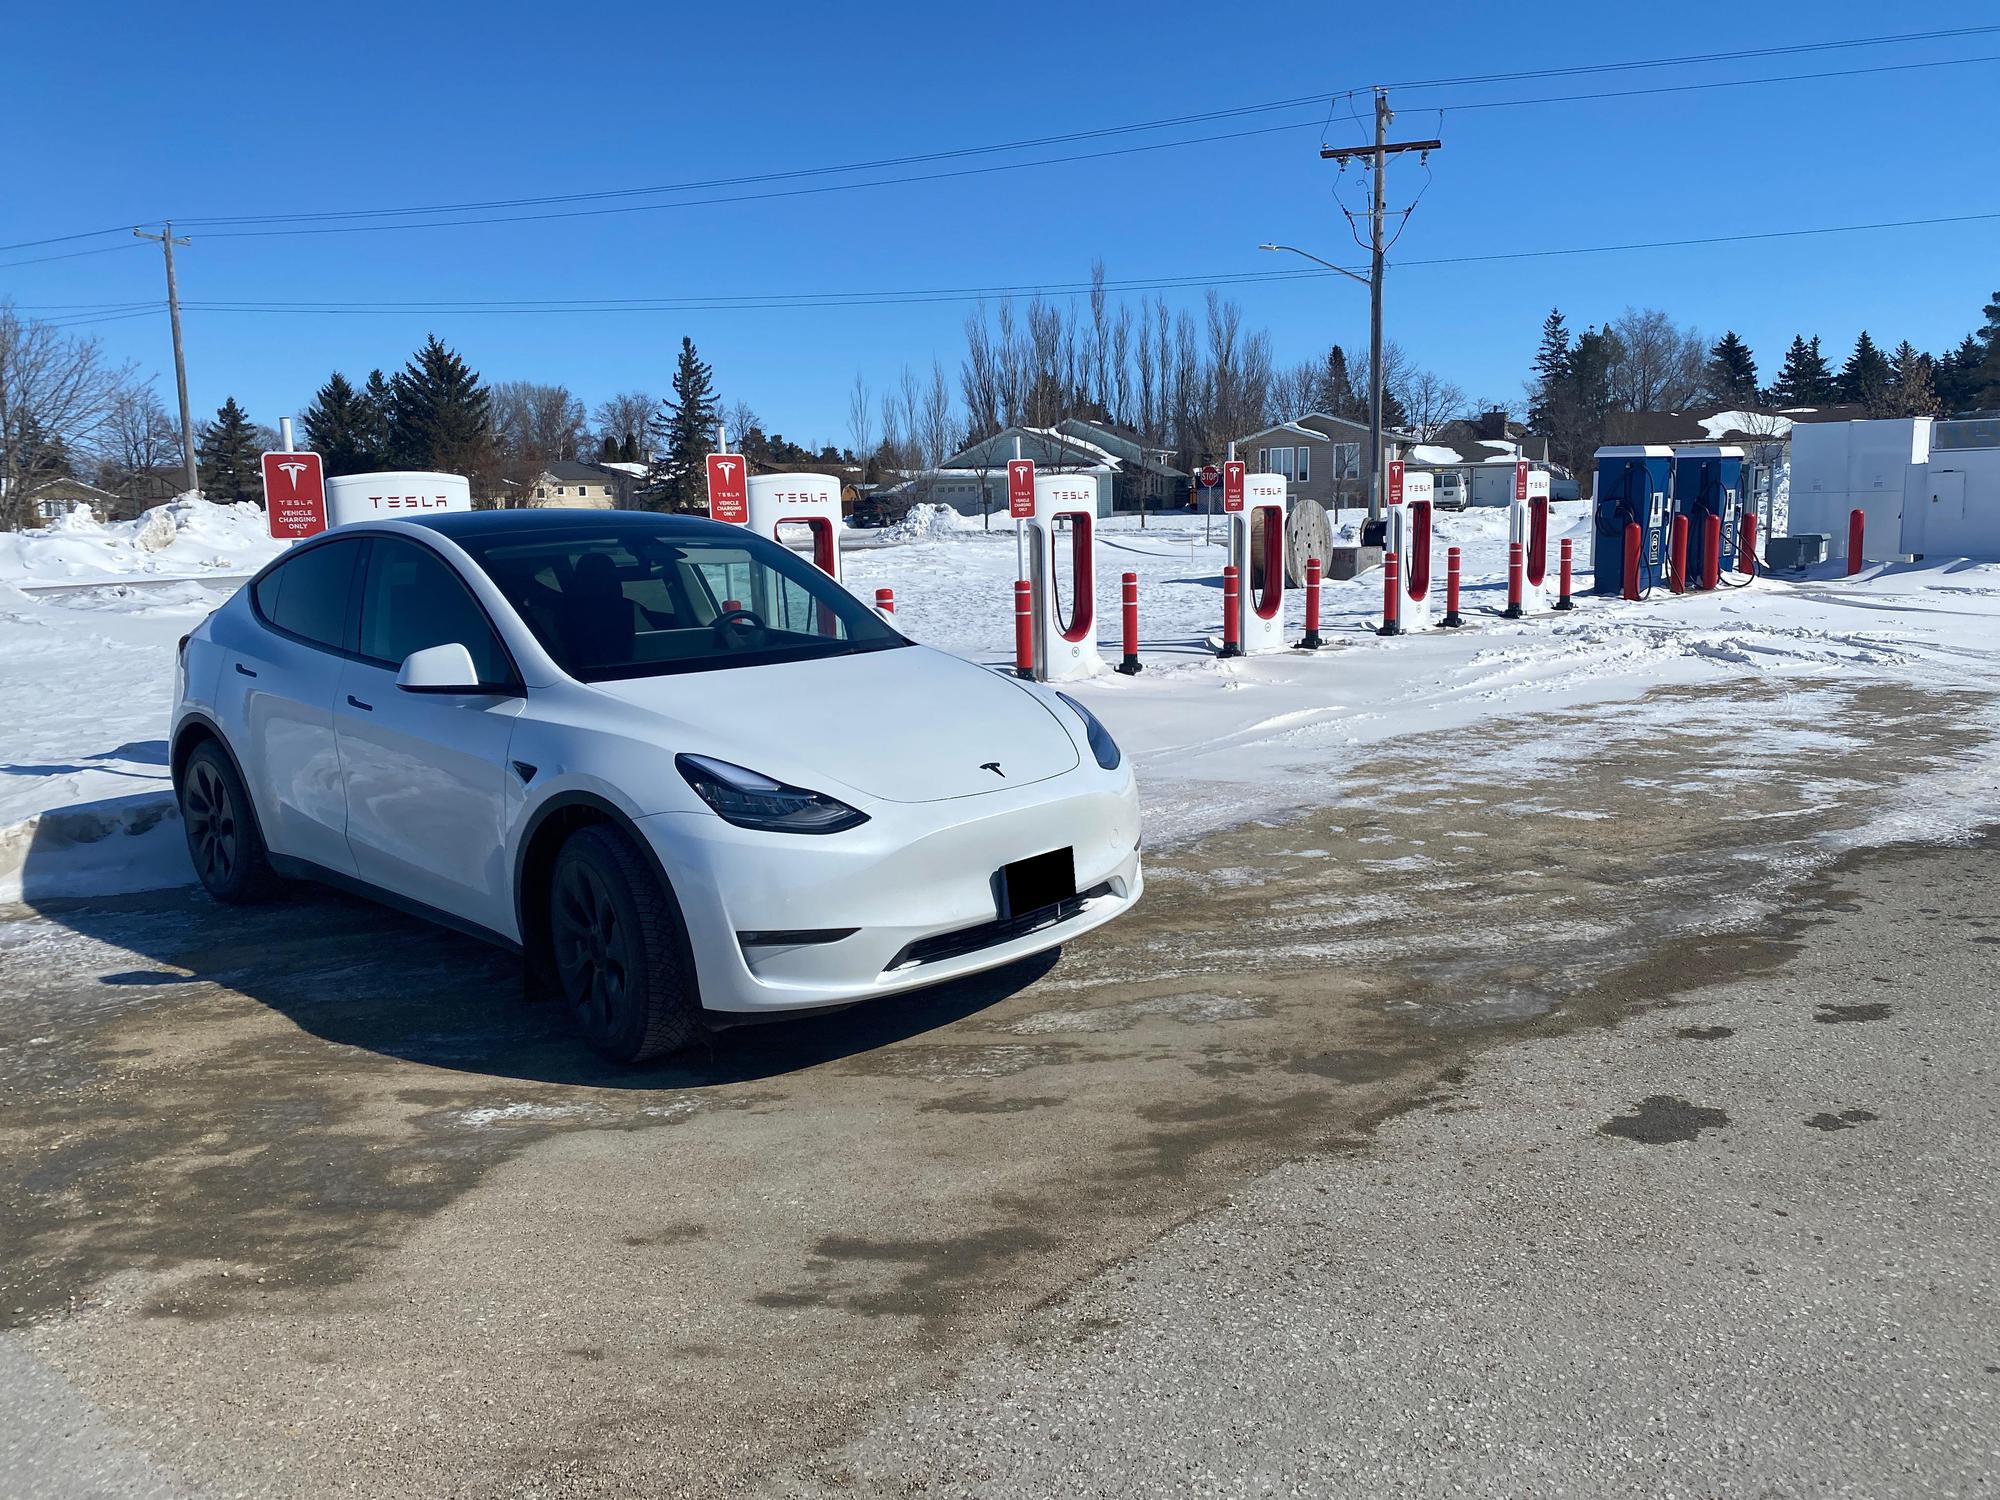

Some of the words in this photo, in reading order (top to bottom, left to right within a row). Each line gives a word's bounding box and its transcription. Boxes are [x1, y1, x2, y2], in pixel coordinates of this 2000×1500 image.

[1202, 472, 1217, 481] STOP
[1253, 487, 1282, 496] TESLA
[1408, 484, 1431, 492] TESLA
[774, 492, 828, 503] TESLA
[1052, 491, 1090, 500] TESLA
[368, 496, 447, 509] TESLA
